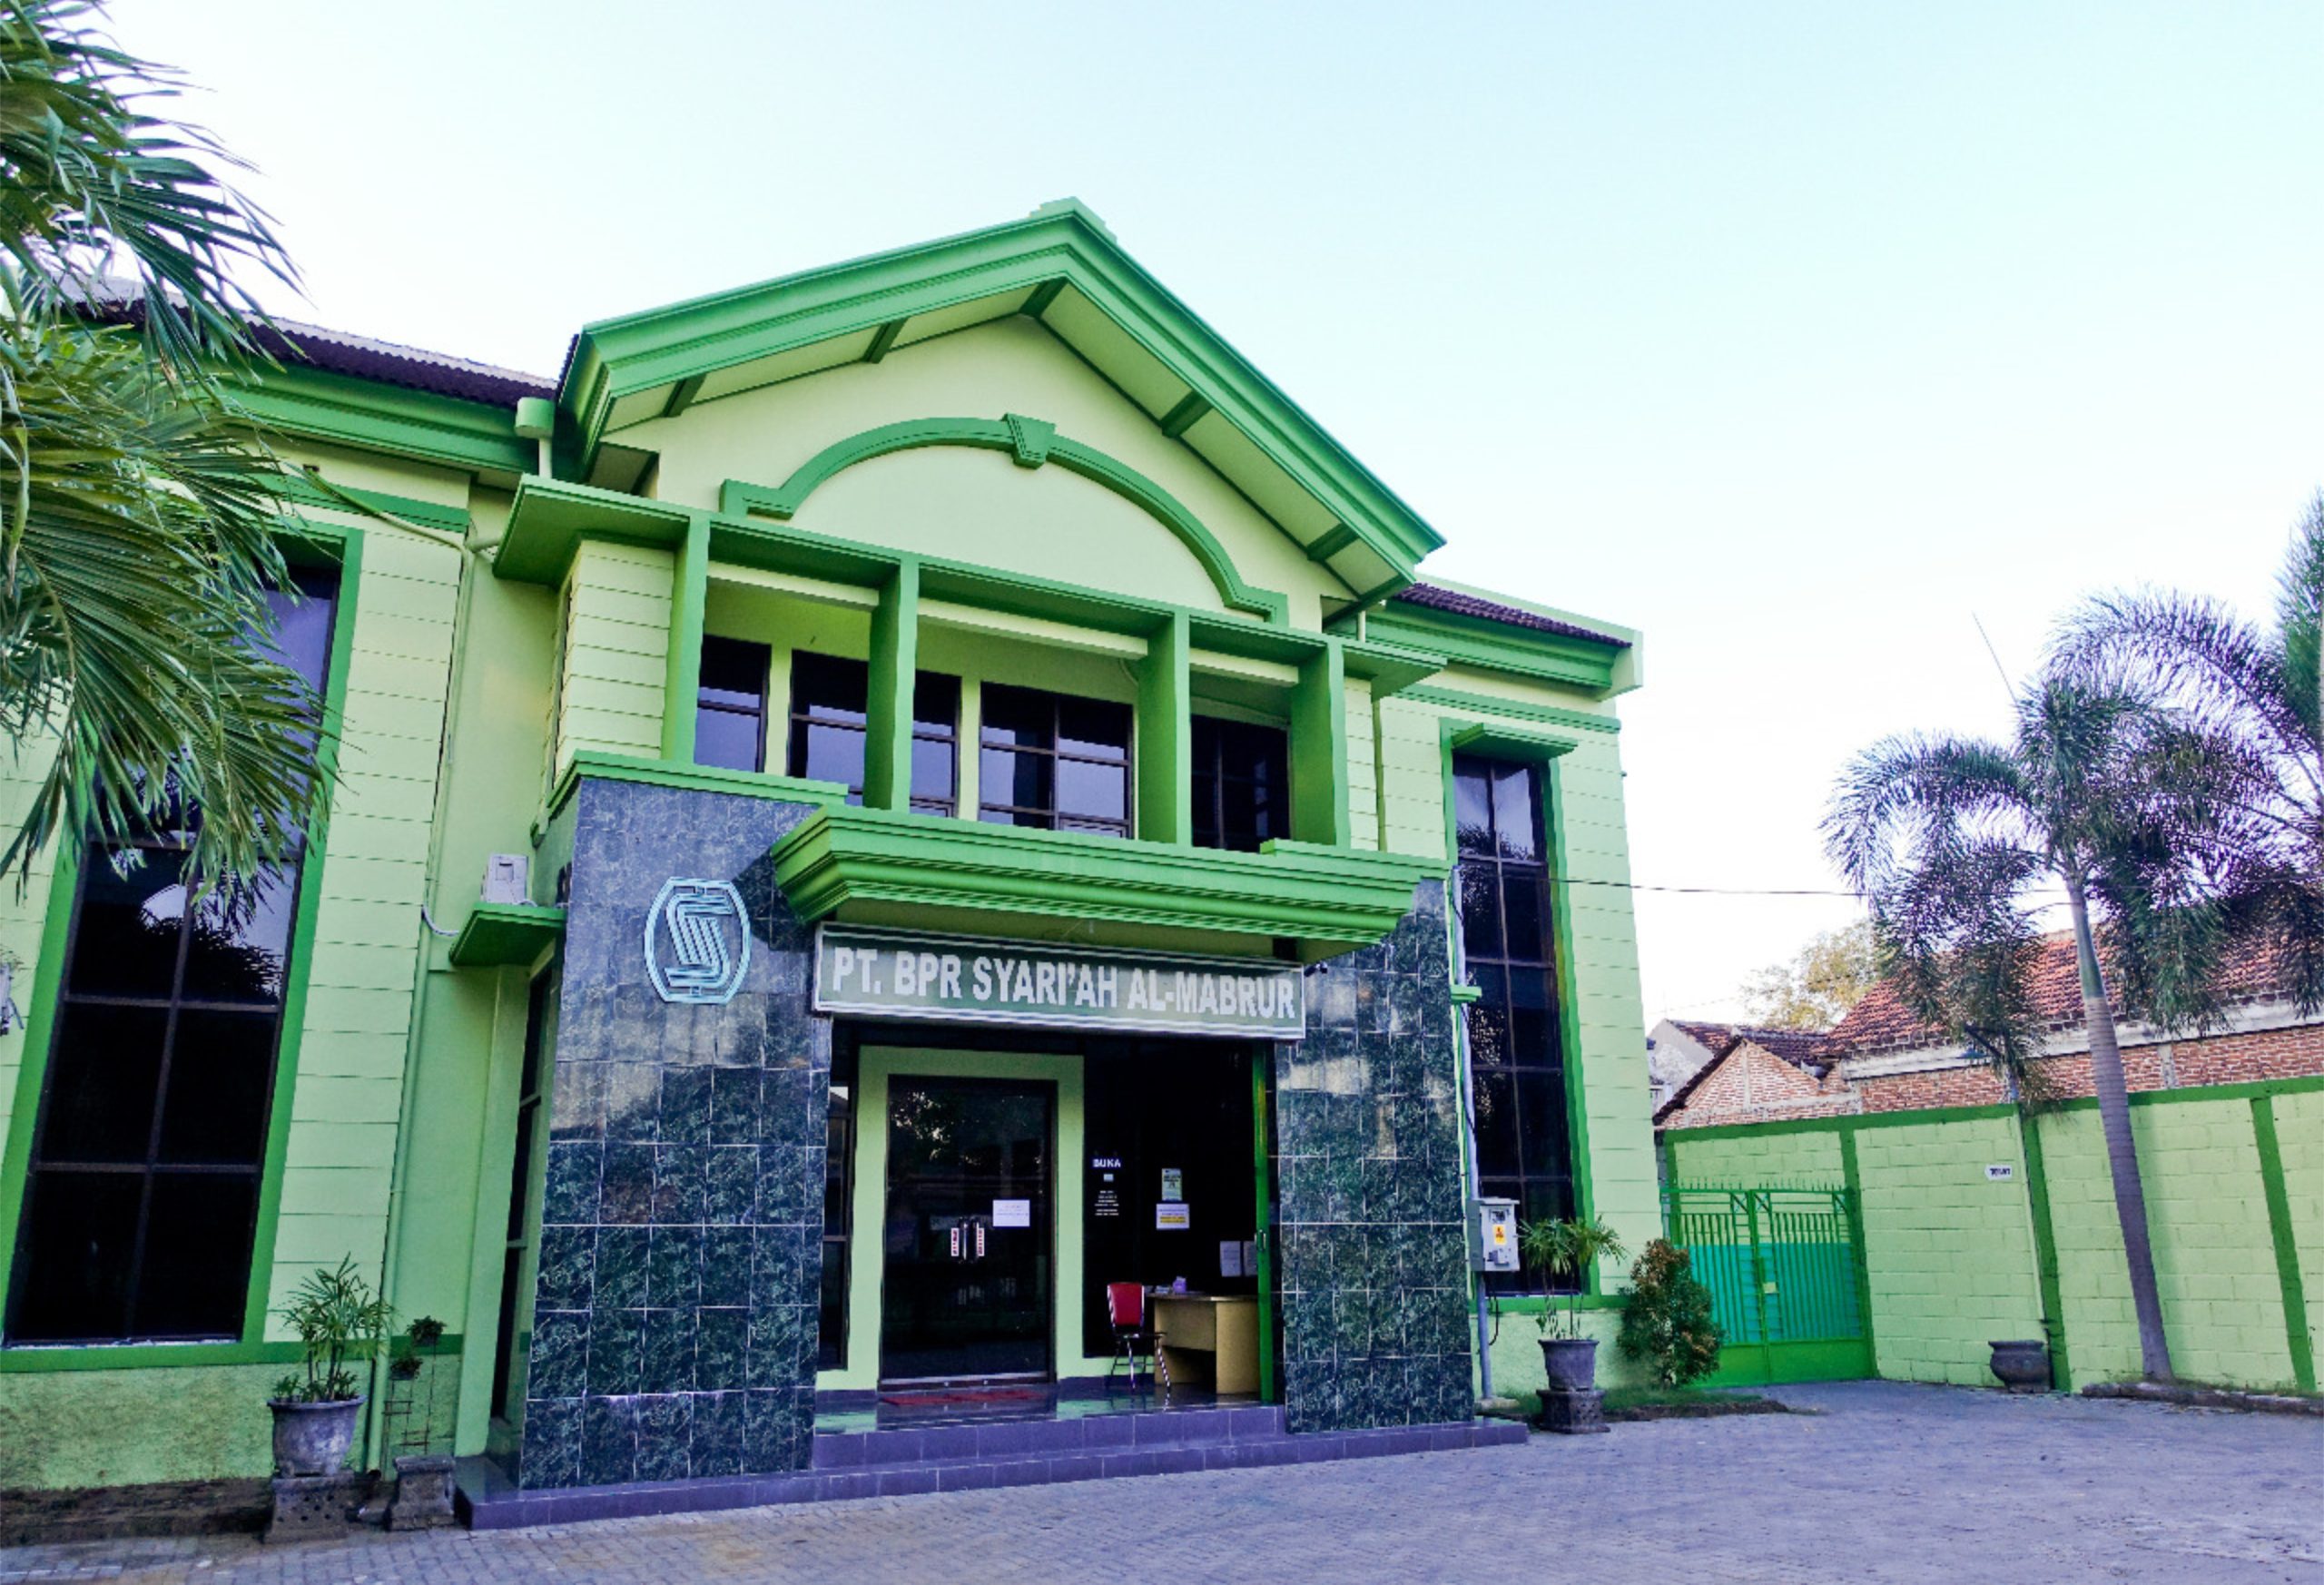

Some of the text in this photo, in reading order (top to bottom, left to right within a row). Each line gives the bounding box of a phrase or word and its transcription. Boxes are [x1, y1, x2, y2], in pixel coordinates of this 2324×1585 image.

[833, 947, 1295, 1019] PT. BPR SYARI'AH AL-MABRUR
[1092, 1158, 1121, 1168] BUKA
